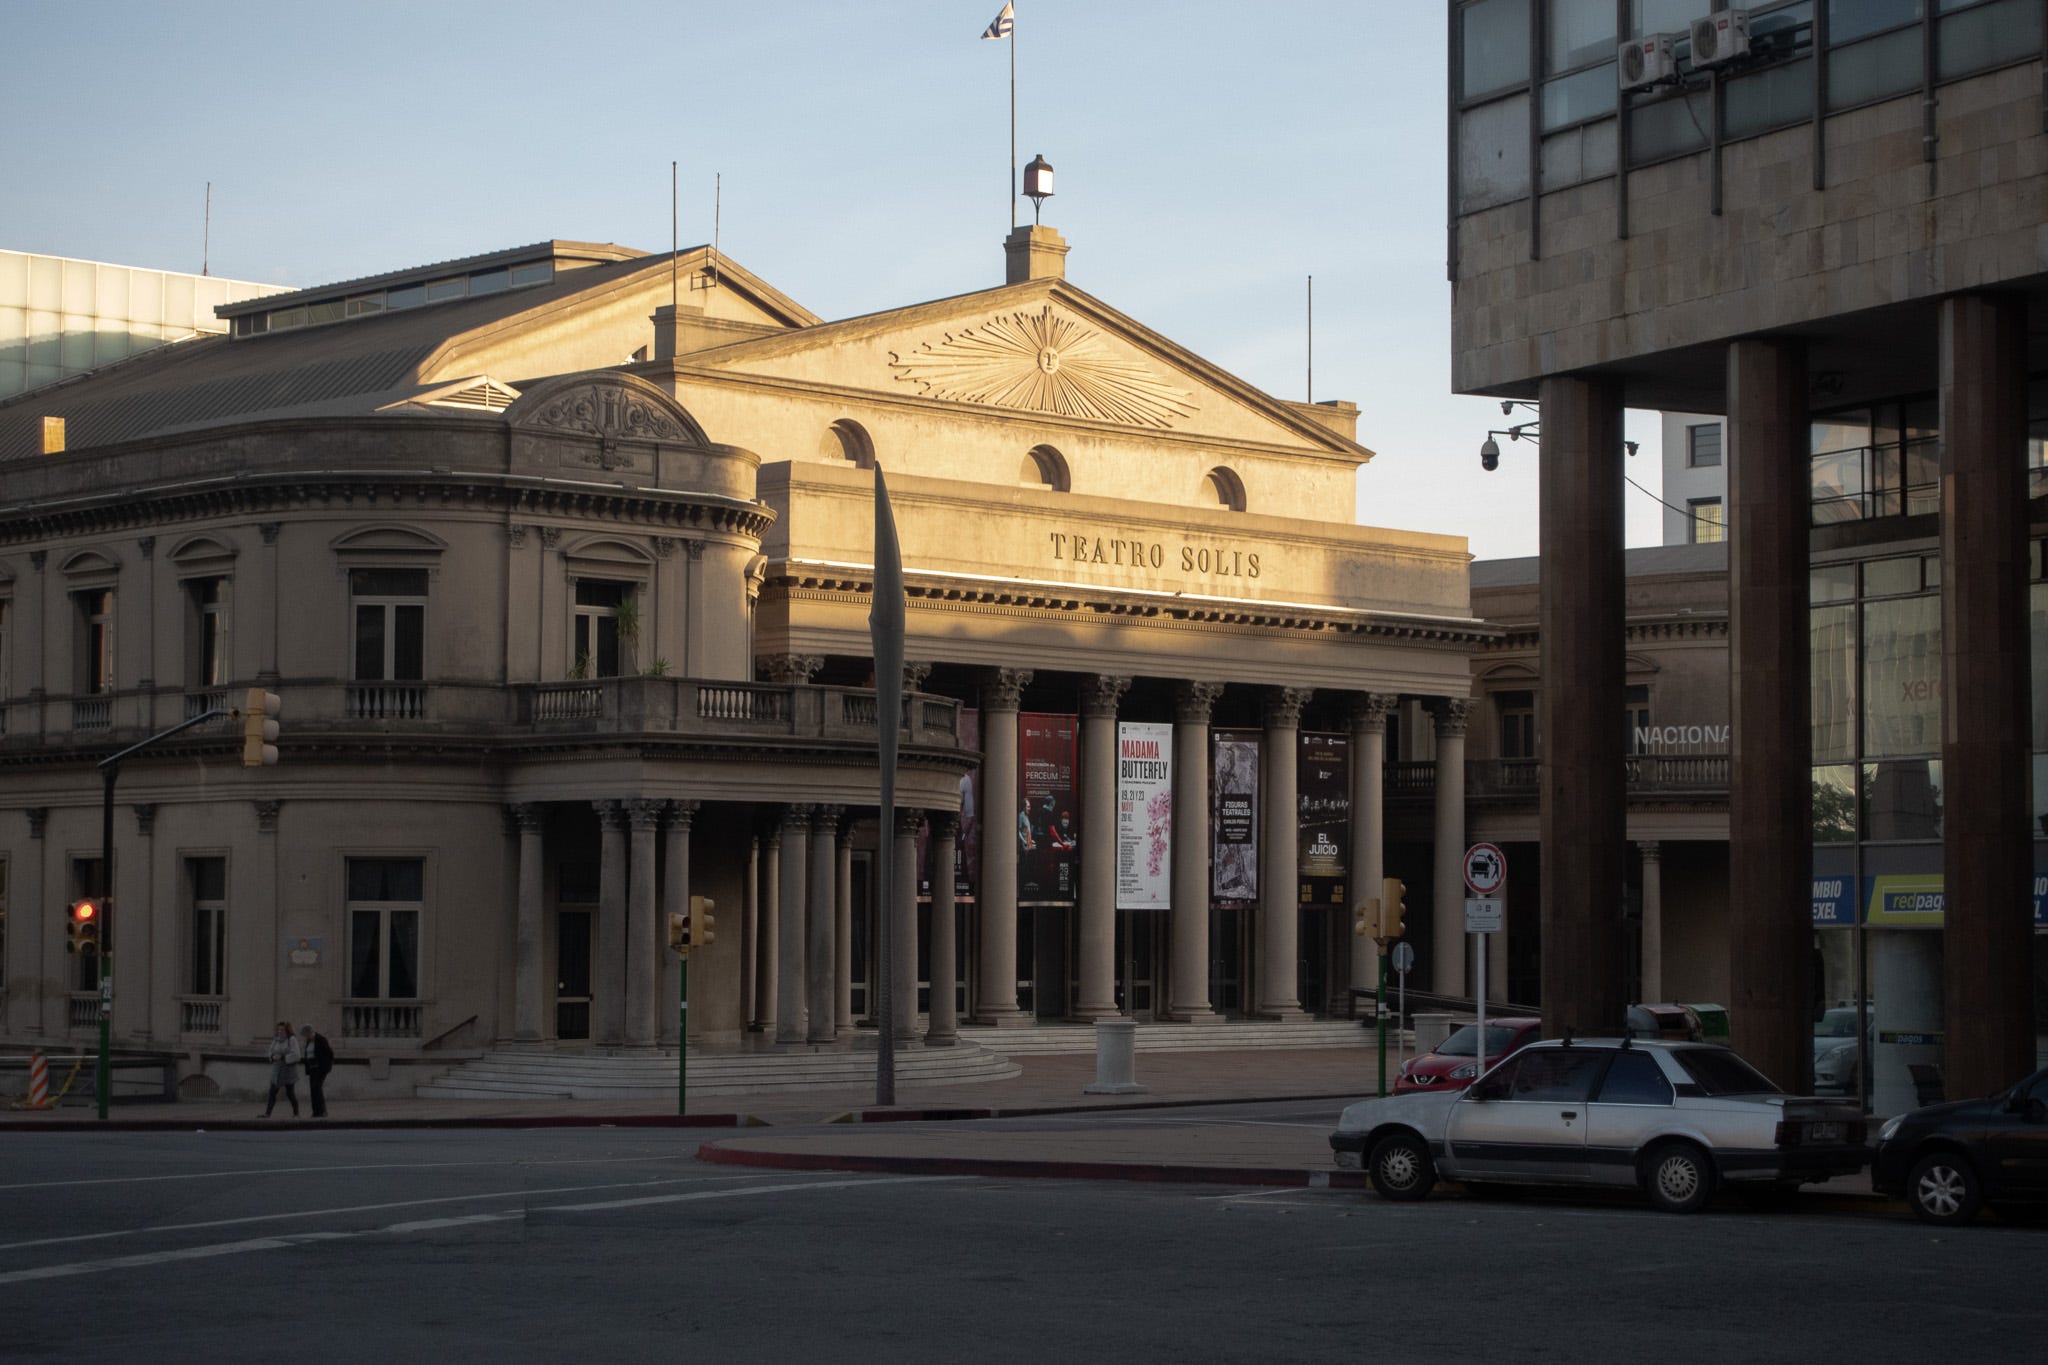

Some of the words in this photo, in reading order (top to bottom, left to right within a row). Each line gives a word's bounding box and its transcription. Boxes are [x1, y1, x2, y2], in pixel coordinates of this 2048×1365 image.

[1050, 532, 1163, 569] TEATRO
[1181, 546, 1260, 579] SOLIS
[1122, 740, 1160, 760] MADAMA
[1025, 771, 1059, 780] PERCEUM
[1122, 760, 1168, 780] BUTTERFLY
[1130, 790, 1135, 801] 21
[1138, 790, 1144, 801] 23
[1225, 801, 1248, 809] FIGURAS
[1222, 808, 1251, 816] TEATRALES
[1318, 833, 1330, 844] EL
[1308, 844, 1338, 855] JUICIO
[1892, 892, 1945, 912] redpag
